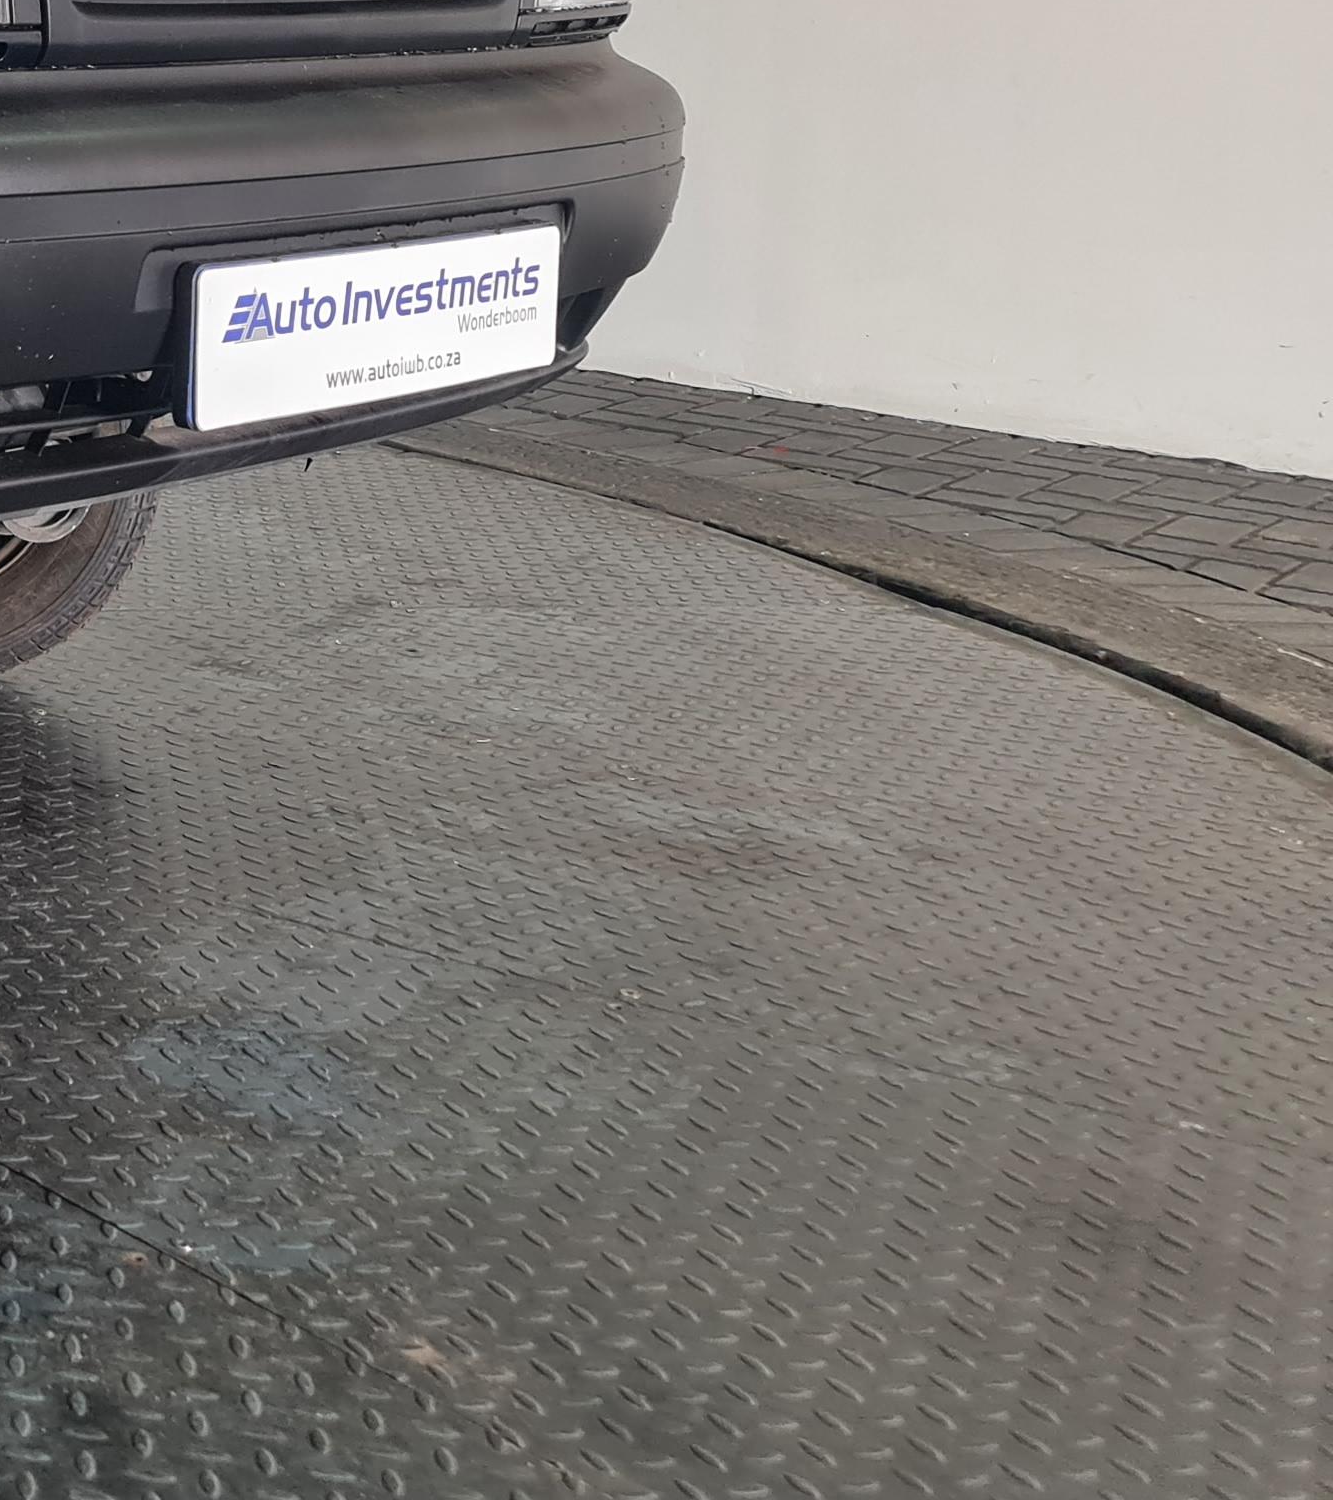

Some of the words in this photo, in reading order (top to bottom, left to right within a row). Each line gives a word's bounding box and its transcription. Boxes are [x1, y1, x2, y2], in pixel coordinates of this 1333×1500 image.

[243, 284, 337, 341] Auto
[341, 256, 541, 326] Investments
[457, 303, 538, 334] Wonderboom
[326, 349, 462, 389] www.autoiwb.co.za
